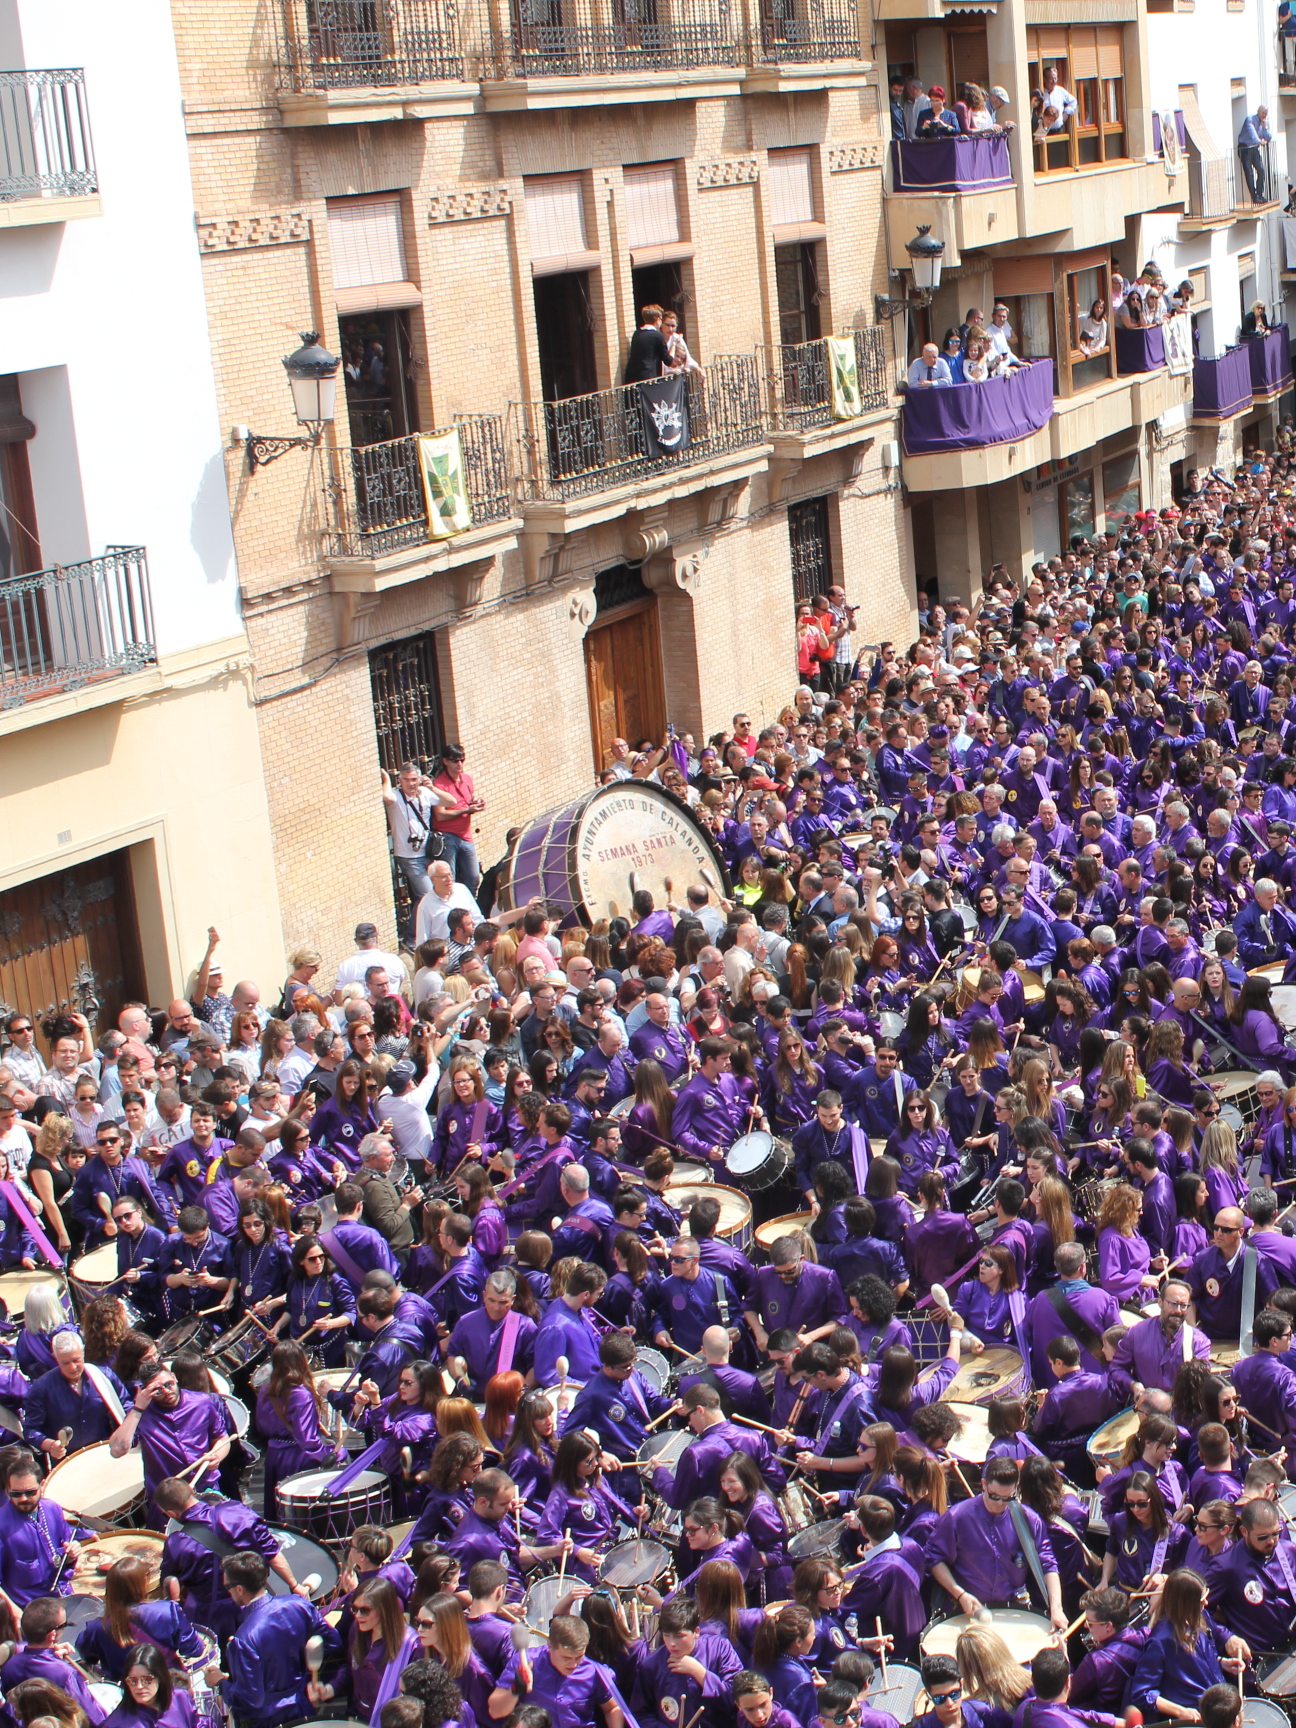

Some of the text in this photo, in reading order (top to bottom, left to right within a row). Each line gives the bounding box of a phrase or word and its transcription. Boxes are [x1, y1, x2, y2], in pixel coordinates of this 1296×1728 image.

[1059, 466, 1080, 481] ESTUDIOS
[581, 798, 635, 862] AYUNTAMIENTO
[641, 800, 654, 815] DE
[660, 810, 705, 864] CALANDA
[598, 842, 639, 862] SEMANA
[642, 834, 677, 852] SANTA
[631, 852, 655, 869] 1973
